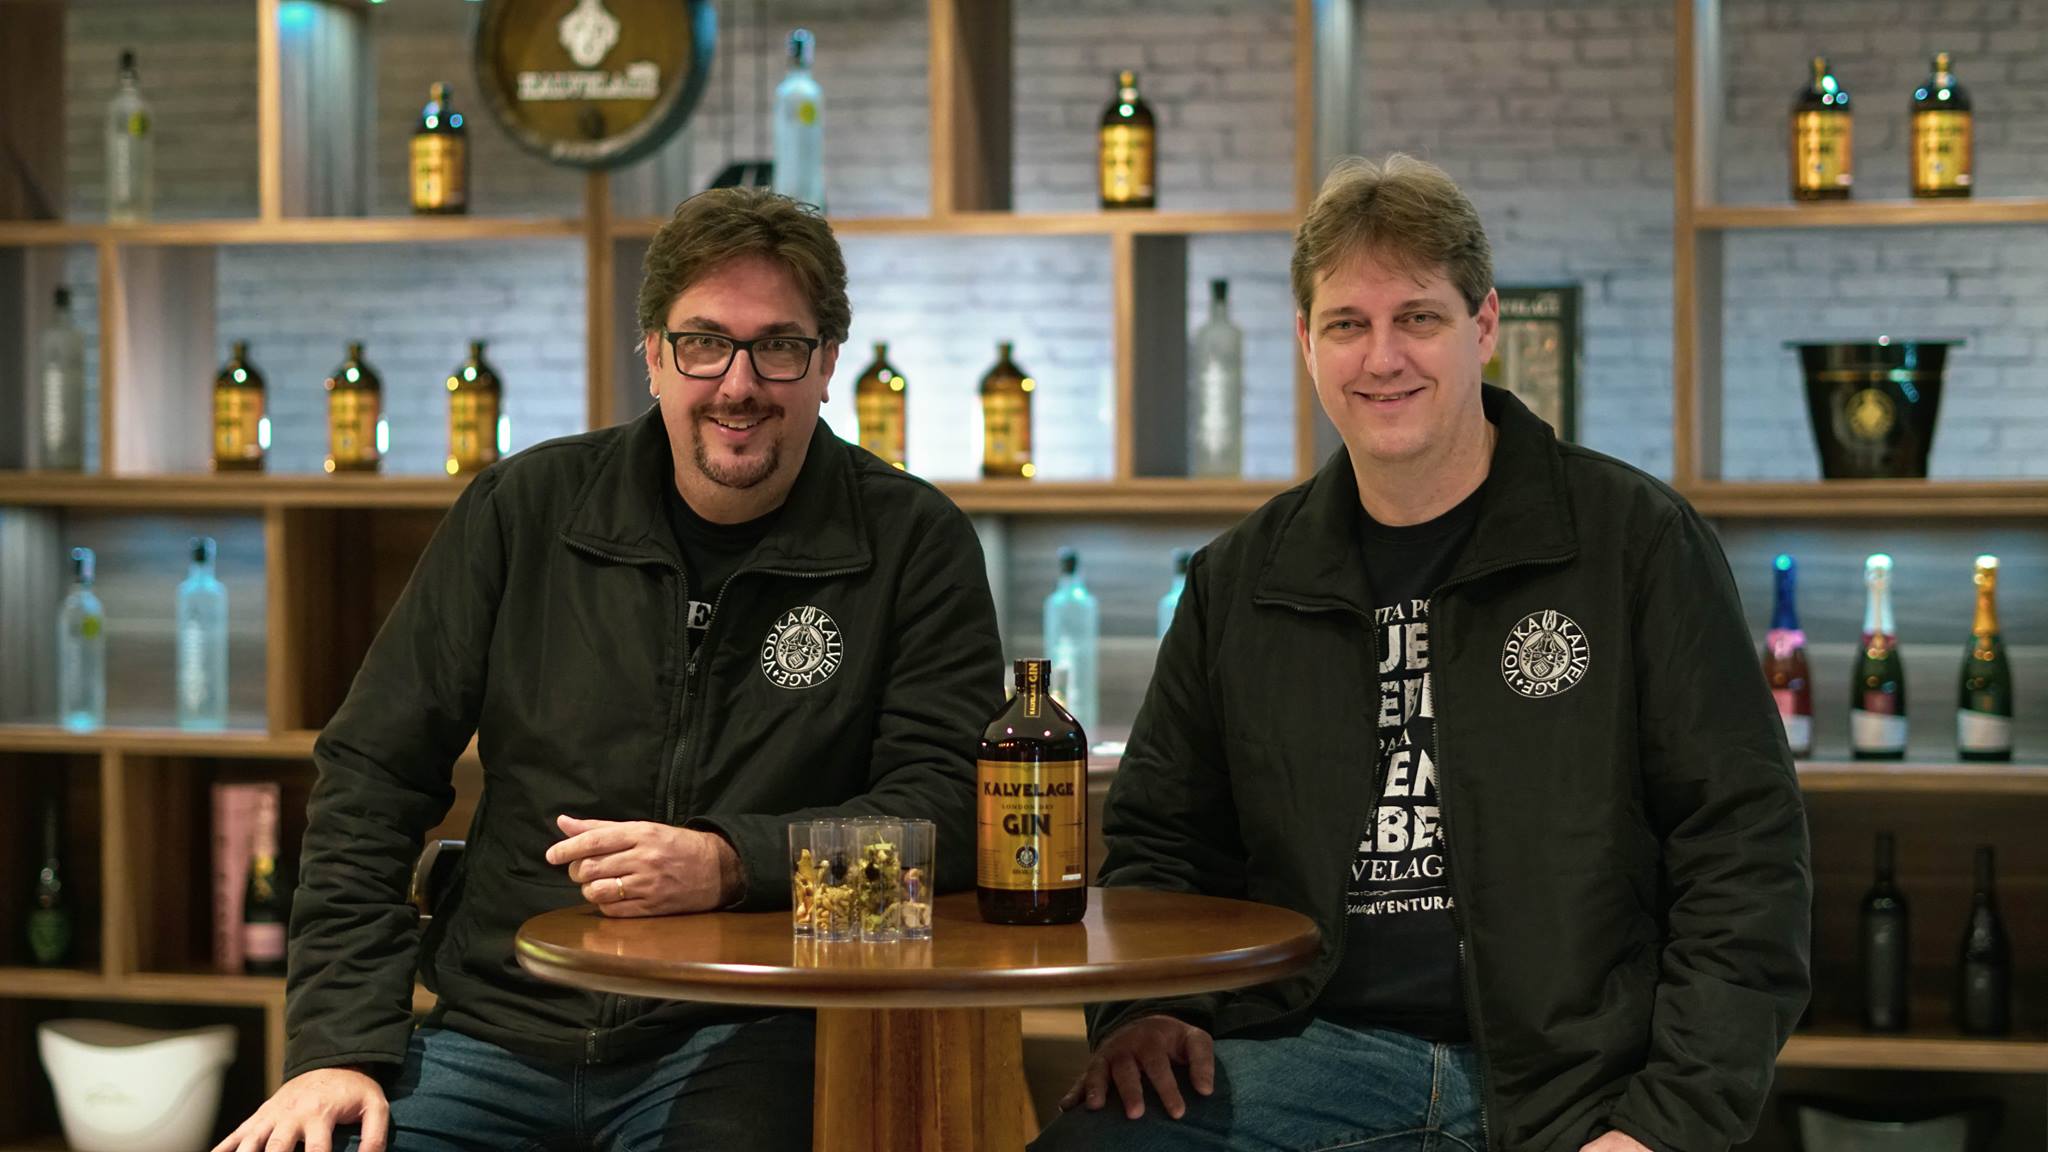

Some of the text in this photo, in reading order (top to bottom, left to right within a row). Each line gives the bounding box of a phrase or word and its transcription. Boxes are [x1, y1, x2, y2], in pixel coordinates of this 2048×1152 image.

[763, 612, 841, 686] VODKA KALVELAGE
[1504, 617, 1587, 695] VODKA KALVELAGE
[1028, 663, 1038, 682] GIN
[984, 782, 1075, 797] KALVELAGE
[1003, 813, 1051, 836] GIN
